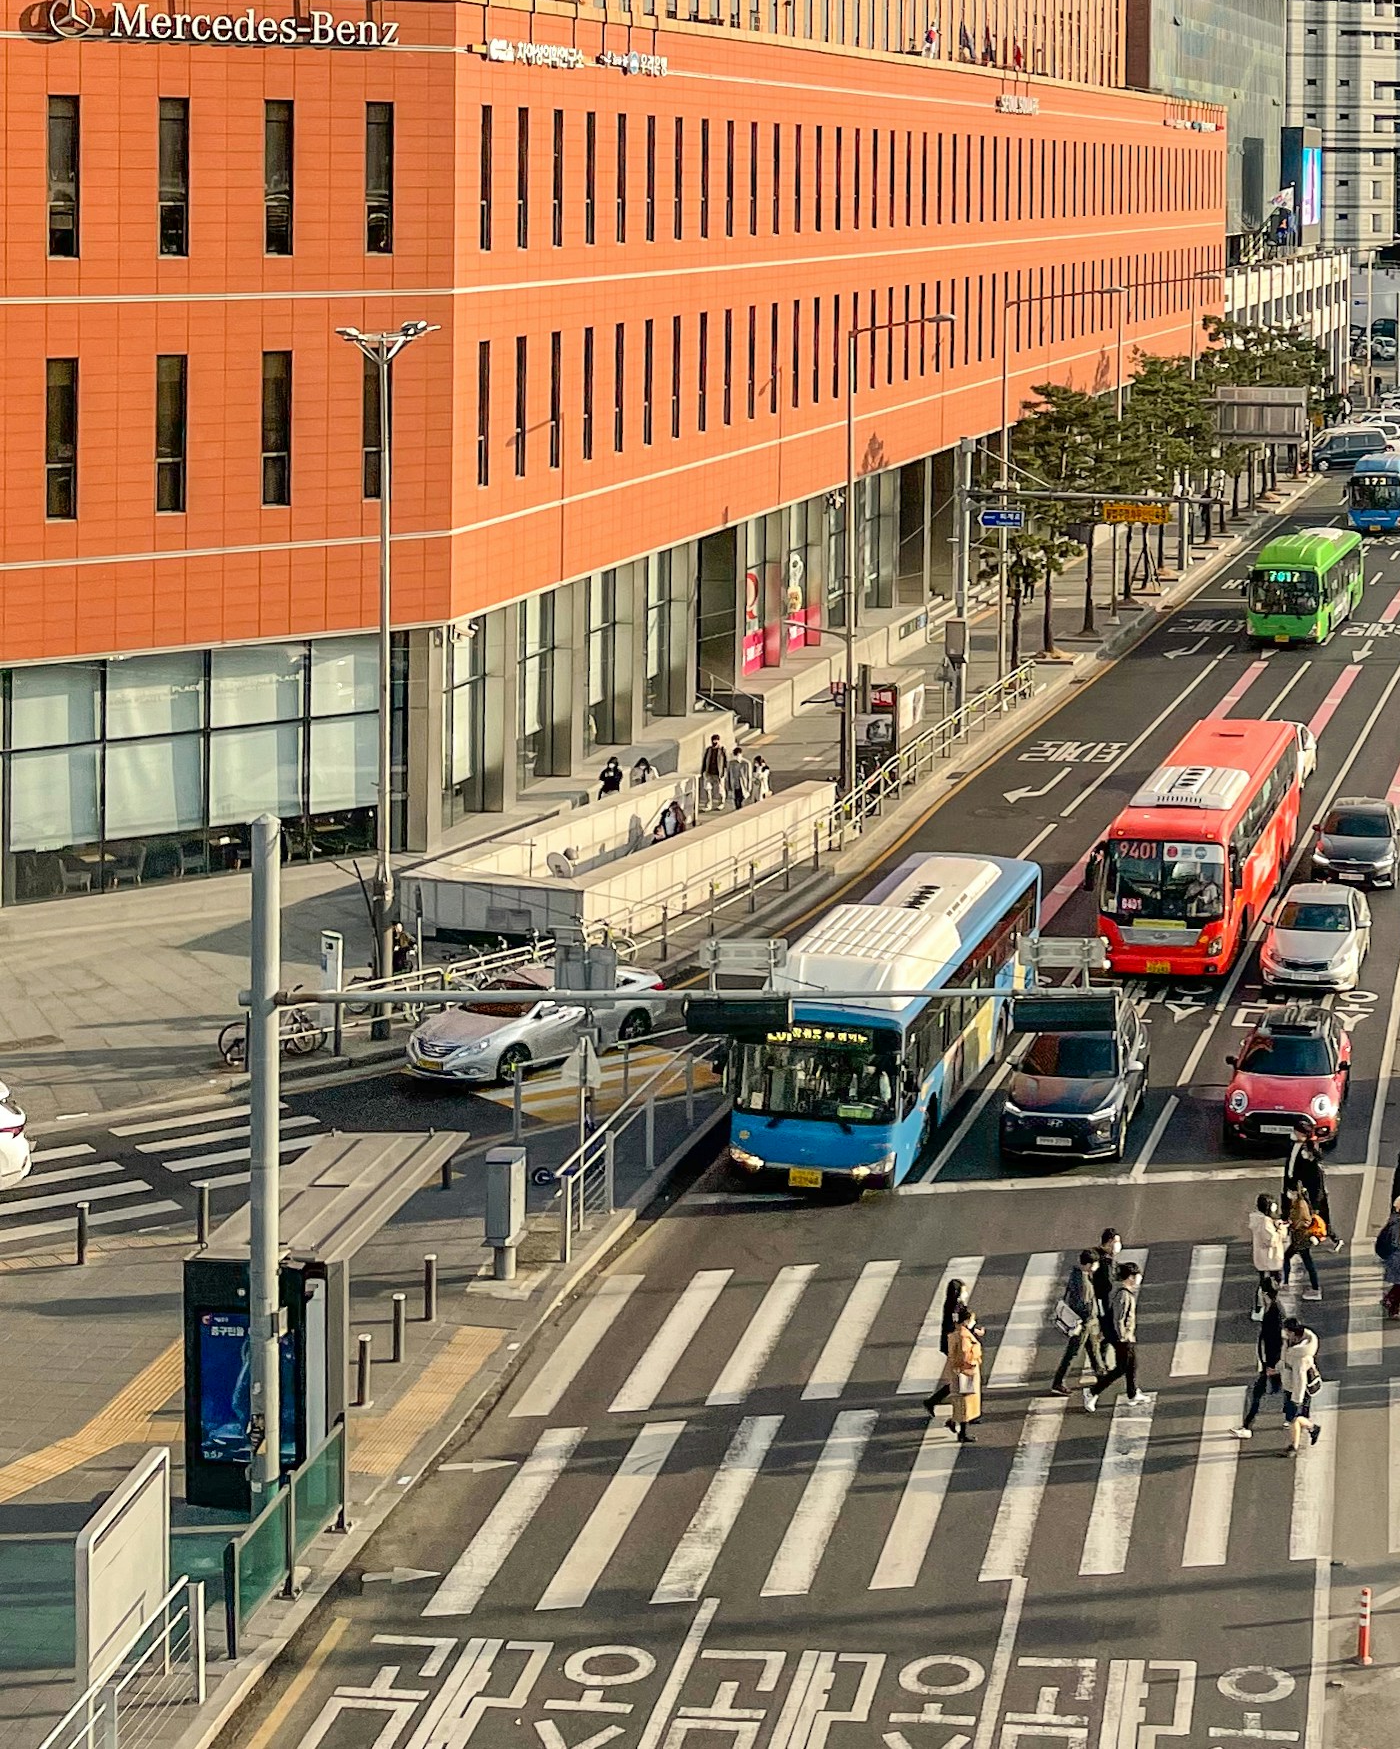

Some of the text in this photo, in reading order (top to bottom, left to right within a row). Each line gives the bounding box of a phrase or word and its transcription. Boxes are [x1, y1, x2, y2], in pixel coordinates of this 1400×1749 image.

[112, 2, 400, 47] Mercedes-Benz
[1363, 477, 1387, 486] 173
[1268, 570, 1300, 582] 7017
[1018, 740, 1128, 764] 퇴계로
[1119, 841, 1158, 859] 9401
[298, 1632, 657, 1749] 숭례문
[662, 1648, 987, 1749] 숭례문
